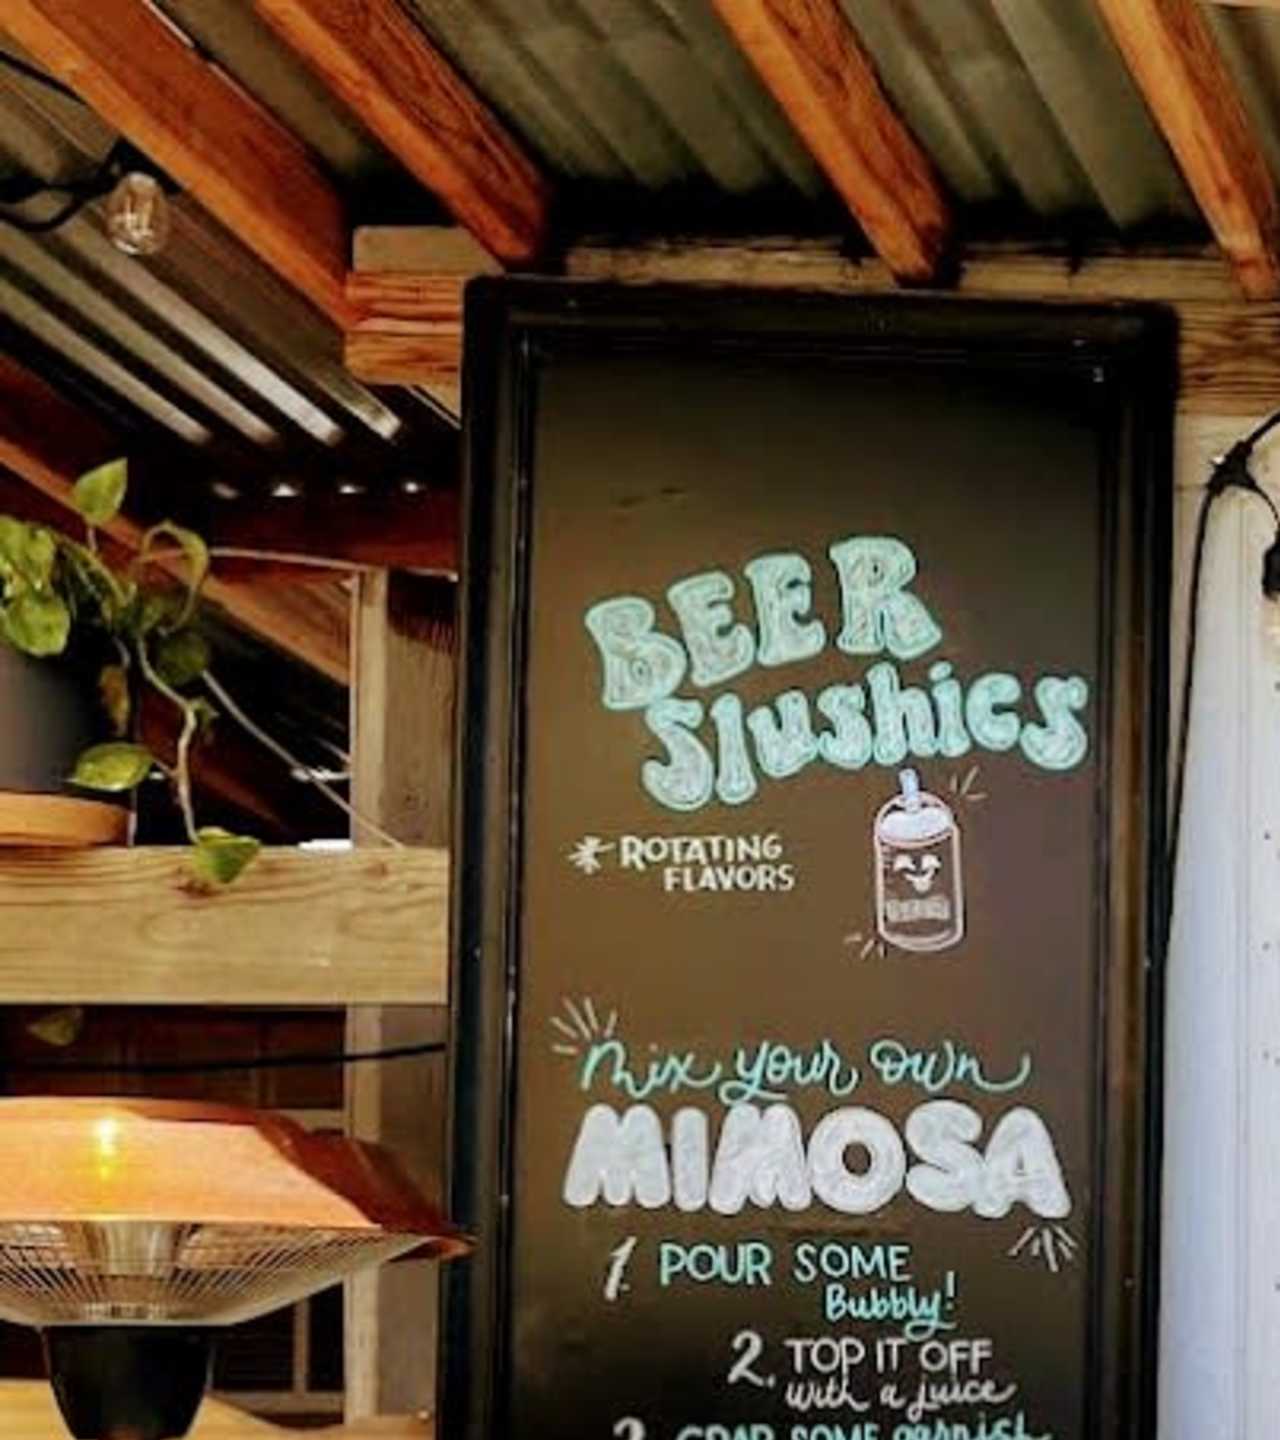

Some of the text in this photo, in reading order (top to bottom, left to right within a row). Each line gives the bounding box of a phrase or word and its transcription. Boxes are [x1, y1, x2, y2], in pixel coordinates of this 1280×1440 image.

[584, 535, 942, 710] BEER
[641, 661, 1089, 812] Slushies
[619, 835, 783, 870] ROTATING
[664, 864, 796, 892] FLAVORS
[719, 1041, 860, 1102] your
[563, 1101, 1072, 1219] MIMOSA
[660, 1243, 771, 1285] POUR
[795, 1244, 910, 1281] SOME
[825, 1272, 956, 1338] Bubbly!
[727, 1330, 993, 1387] 2. TOP IT OFF
[785, 1376, 1017, 1421] with a juice
